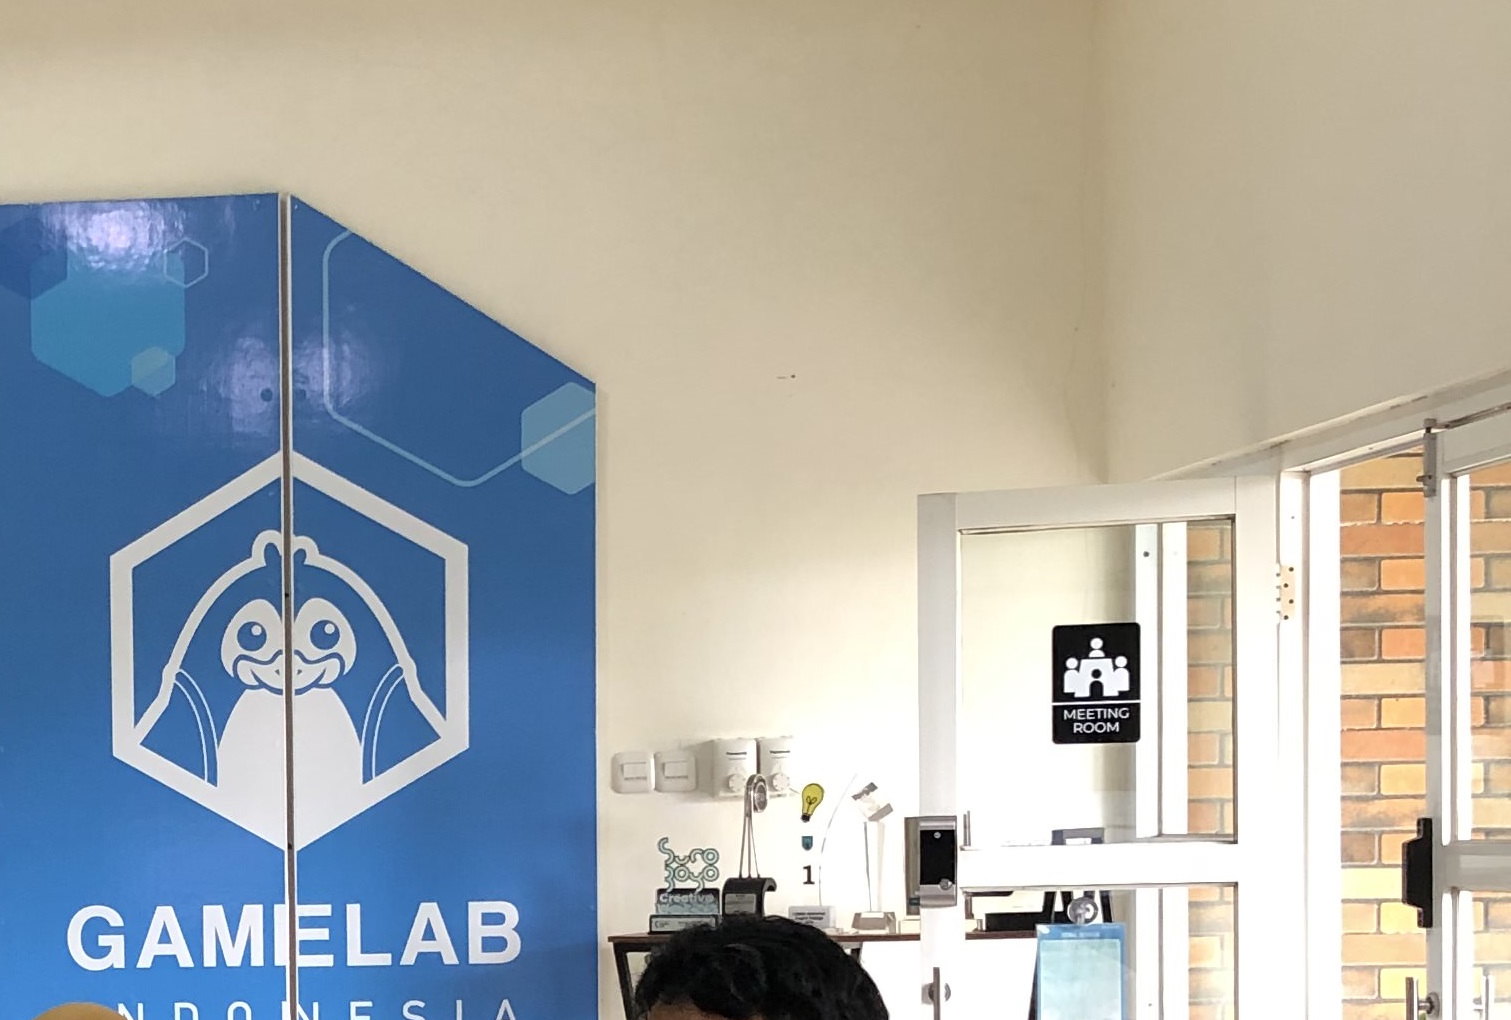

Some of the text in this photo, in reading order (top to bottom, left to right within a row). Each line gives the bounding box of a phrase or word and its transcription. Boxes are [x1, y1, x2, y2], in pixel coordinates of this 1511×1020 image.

[1063, 707, 1130, 721] MEETING
[1073, 721, 1120, 734] ROOM
[802, 865, 816, 885] 1
[67, 901, 522, 972] GAMELAB
